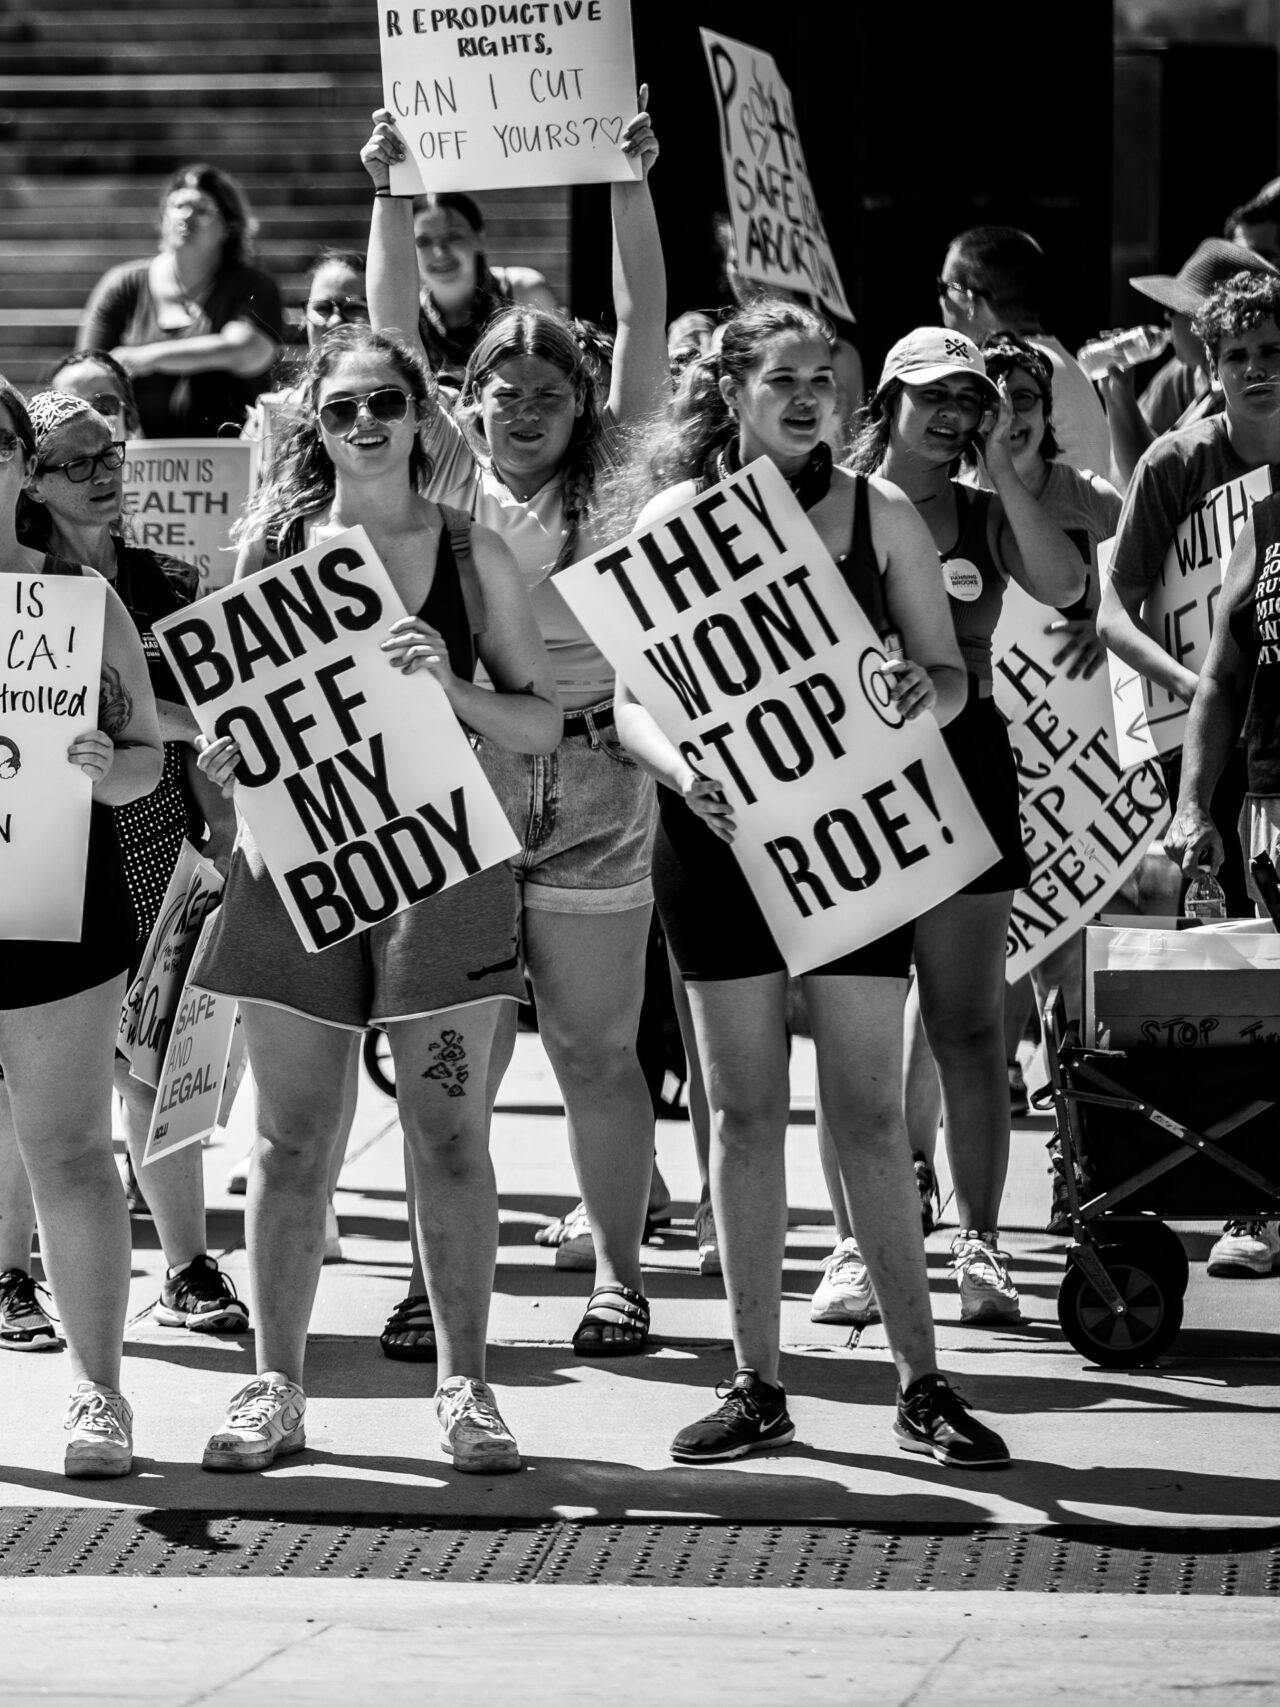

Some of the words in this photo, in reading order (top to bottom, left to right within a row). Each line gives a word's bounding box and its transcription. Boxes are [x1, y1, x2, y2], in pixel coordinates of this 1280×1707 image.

[386, 0, 602, 37] REPRODUCTIVE
[457, 33, 553, 57] RIGHTS,
[392, 76, 457, 117] CAN
[489, 73, 498, 110] I
[530, 68, 584, 103] CUT
[419, 131, 468, 160] OFF
[493, 117, 598, 158] YOURS?
[733, 156, 803, 228] SAFE
[122, 459, 189, 483] ORTION
[197, 458, 214, 482] IS
[122, 491, 229, 515] EALTH
[1172, 480, 1249, 577] WITH
[594, 473, 788, 632] THEY
[16, 581, 44, 618] IS
[162, 547, 384, 706] BANS
[643, 564, 840, 721] WONT
[214, 654, 367, 788] OFF
[1068, 726, 1125, 805] IT
[282, 732, 401, 855] MY
[764, 758, 955, 919] ROE!
[283, 786, 482, 950] BODY
[175, 992, 217, 1036] SAFE
[165, 1035, 194, 1077] AND
[159, 1063, 218, 1115] LEGAL.
[153, 1121, 170, 1142] ACLU
